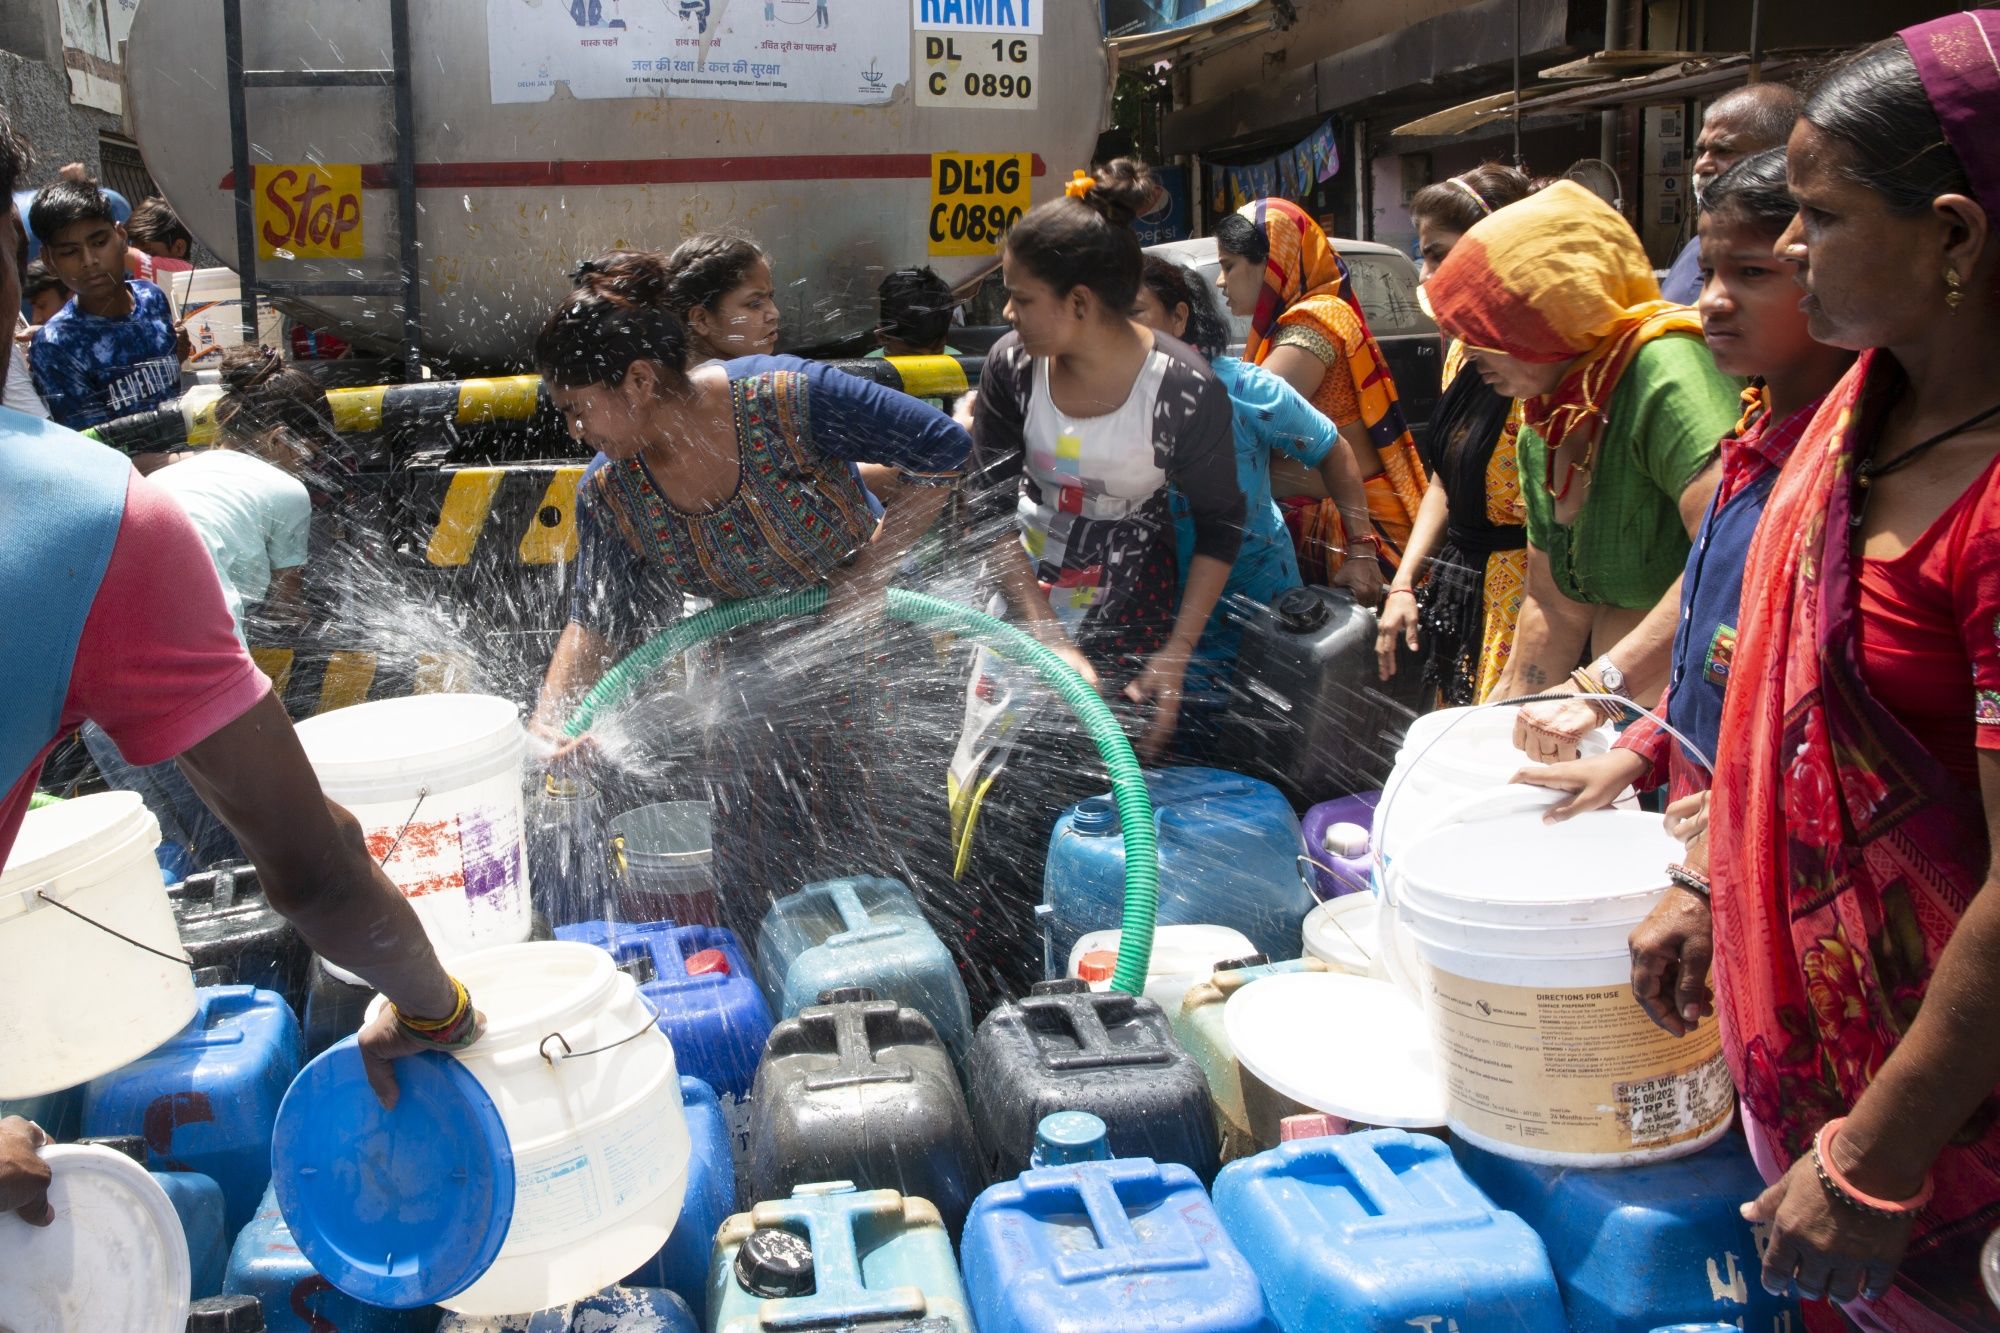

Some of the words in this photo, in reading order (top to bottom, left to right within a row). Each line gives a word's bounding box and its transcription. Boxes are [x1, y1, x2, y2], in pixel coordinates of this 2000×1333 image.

[926, 36, 962, 61] DL
[991, 38, 1028, 63] 1G
[632, 60, 651, 72] जल
[655, 57, 670, 71] की
[674, 60, 695, 72] रक्षा
[708, 61, 730, 73] कल
[733, 59, 748, 74] की
[751, 62, 781, 79] सुरक्षा
[517, 80, 536, 88] DELHI
[928, 71, 947, 95] C
[964, 72, 1032, 99] 0890
[1536, 993, 1584, 1001] DIRECTIONS
[1585, 992, 1602, 1000] FOR
[1603, 991, 1619, 999] USE
